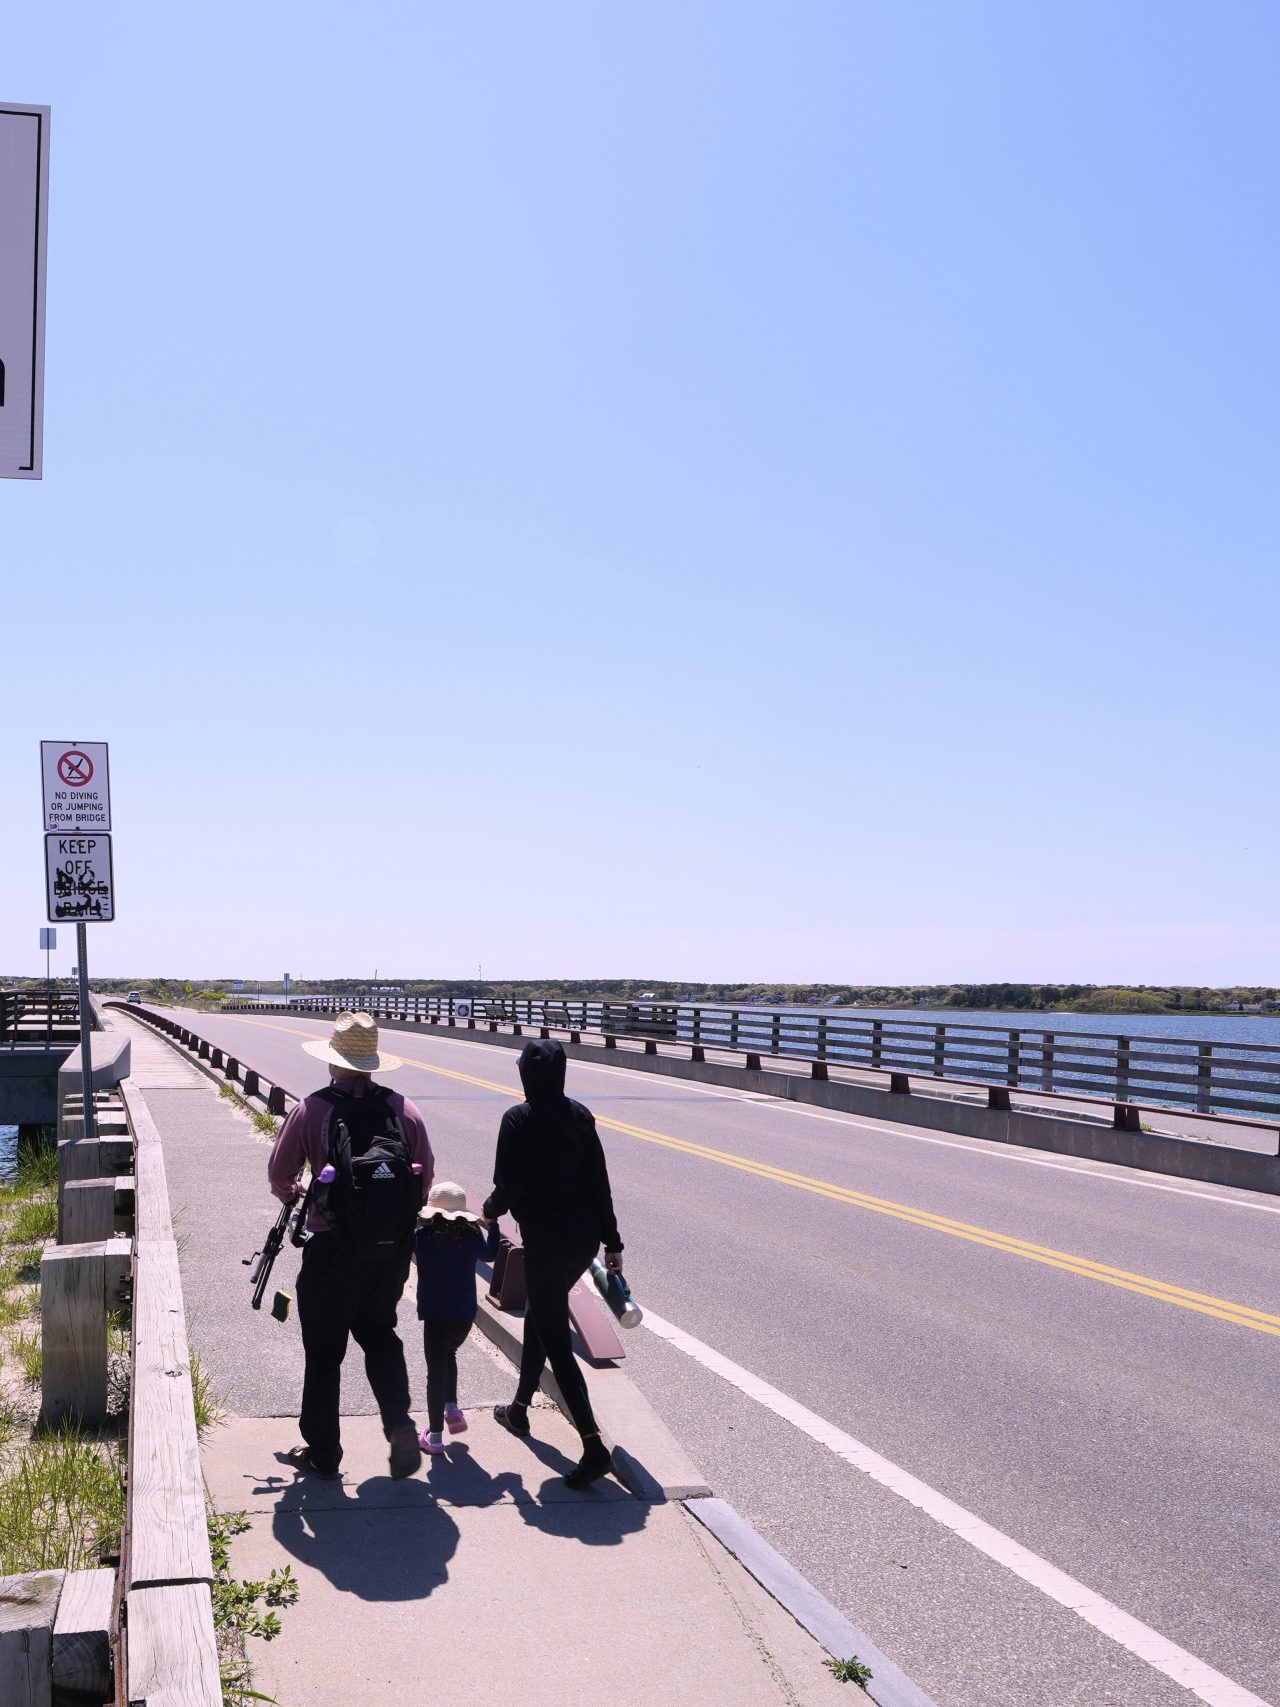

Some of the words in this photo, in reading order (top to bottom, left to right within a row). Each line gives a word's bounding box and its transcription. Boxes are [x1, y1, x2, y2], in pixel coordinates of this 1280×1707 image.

[55, 792, 67, 800] NO
[70, 792, 98, 800] DIVING
[51, 803, 63, 811] OR
[66, 803, 103, 811] JUMPING
[48, 813, 73, 822] FROM
[75, 814, 107, 822] BRIDGE
[59, 839, 97, 854] KEEP
[64, 860, 93, 875] OFF
